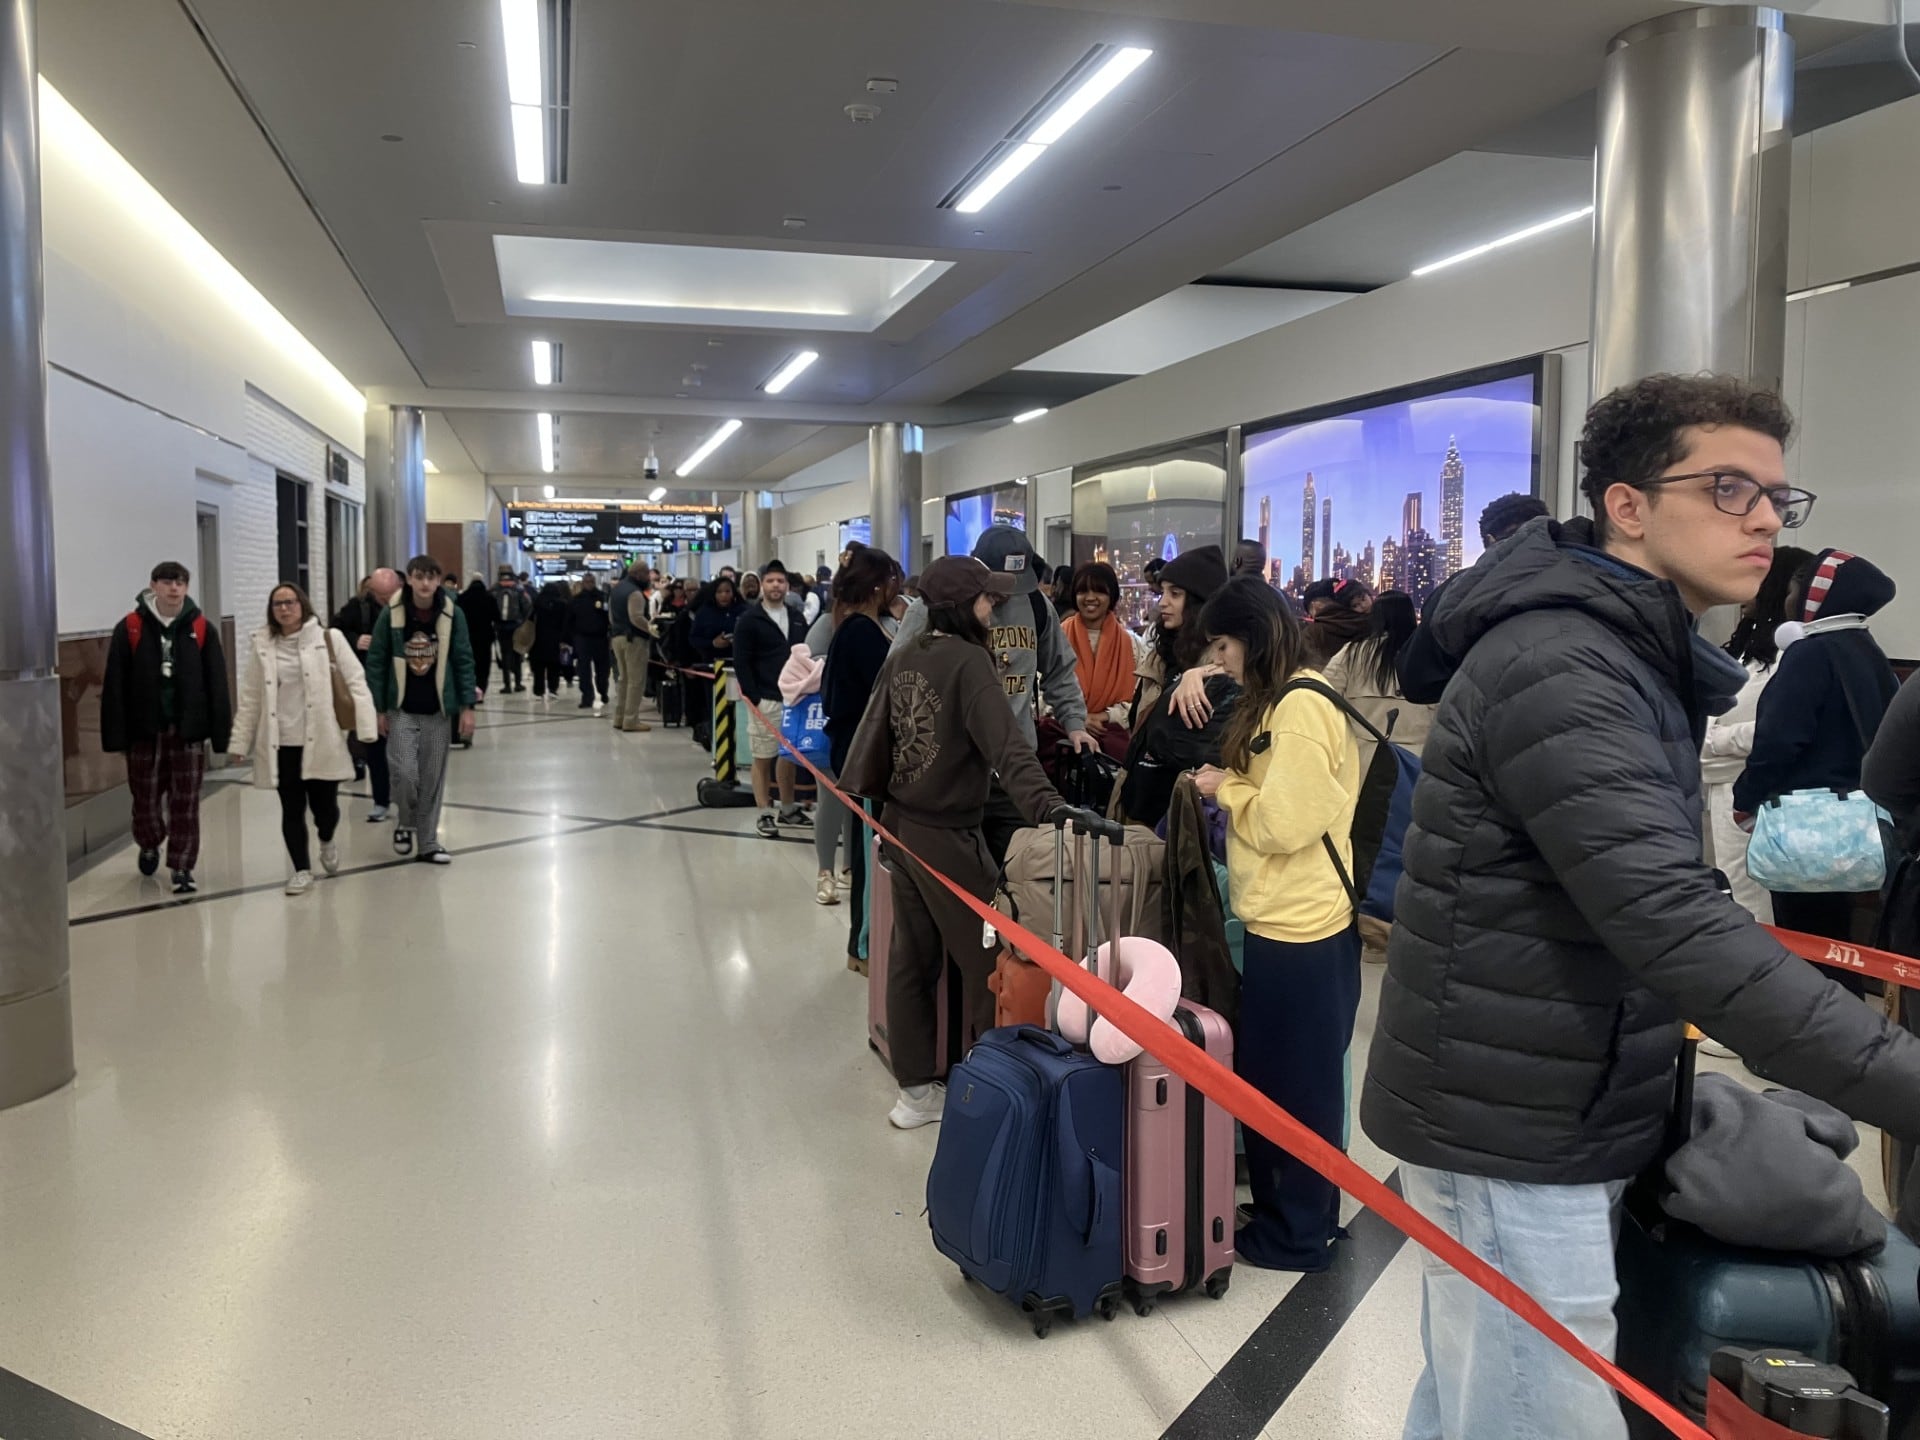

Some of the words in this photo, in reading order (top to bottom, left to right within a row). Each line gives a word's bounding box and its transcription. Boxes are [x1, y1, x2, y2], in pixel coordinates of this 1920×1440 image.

[619, 526, 646, 535] Ground
[646, 526, 696, 536] Transportation
[988, 625, 1037, 650] IZONA
[1824, 943, 1865, 967] ATL
